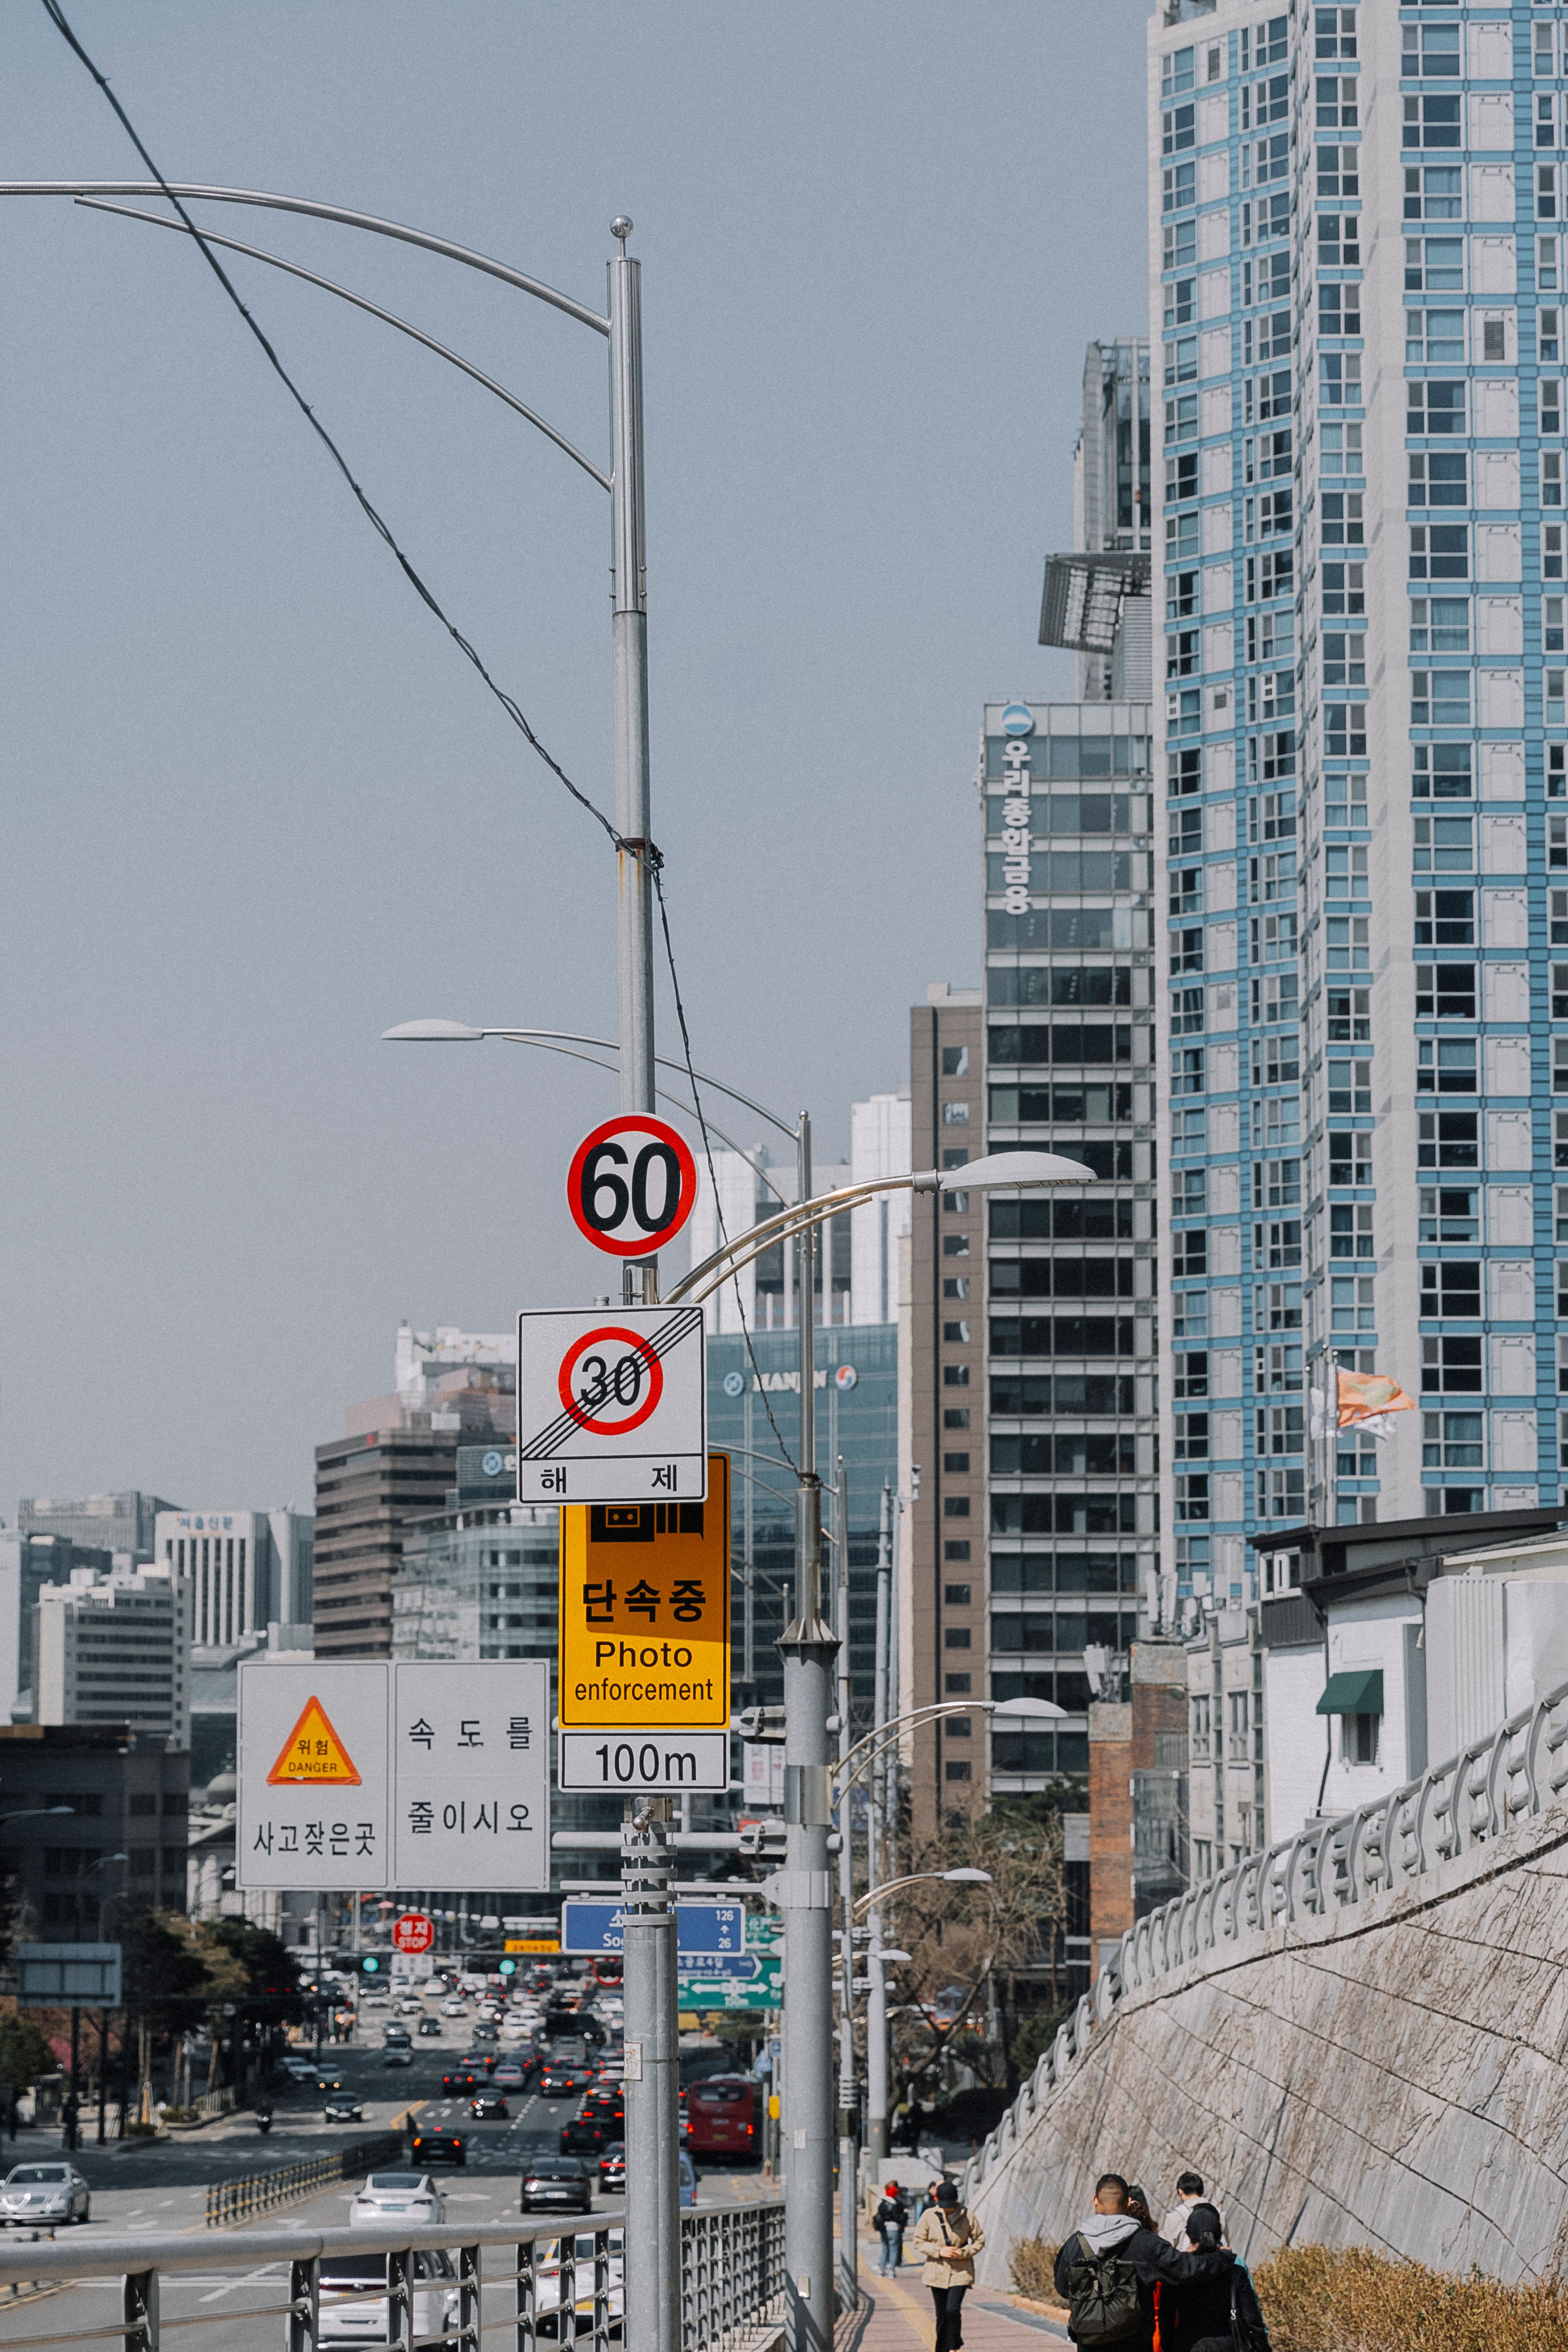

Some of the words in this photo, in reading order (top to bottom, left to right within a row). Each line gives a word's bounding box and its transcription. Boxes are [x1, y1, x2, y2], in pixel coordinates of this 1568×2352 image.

[1002, 740, 1032, 915] 우리종합금융
[580, 1142, 680, 1232] 60
[580, 1356, 641, 1406] 30
[753, 1370, 827, 1394] HANJN
[583, 1579, 706, 1623] 단속중
[595, 1642, 692, 1668] Photo
[575, 1677, 713, 1701] enforcement
[297, 1738, 329, 1756] 위험
[288, 1761, 337, 1773] DANGER
[595, 1743, 697, 1782] 100m
[409, 1801, 533, 1834] 줄이시오
[716, 1910, 734, 1921] 126
[398, 1936, 428, 1949] STOP
[718, 1937, 732, 1948] 26
